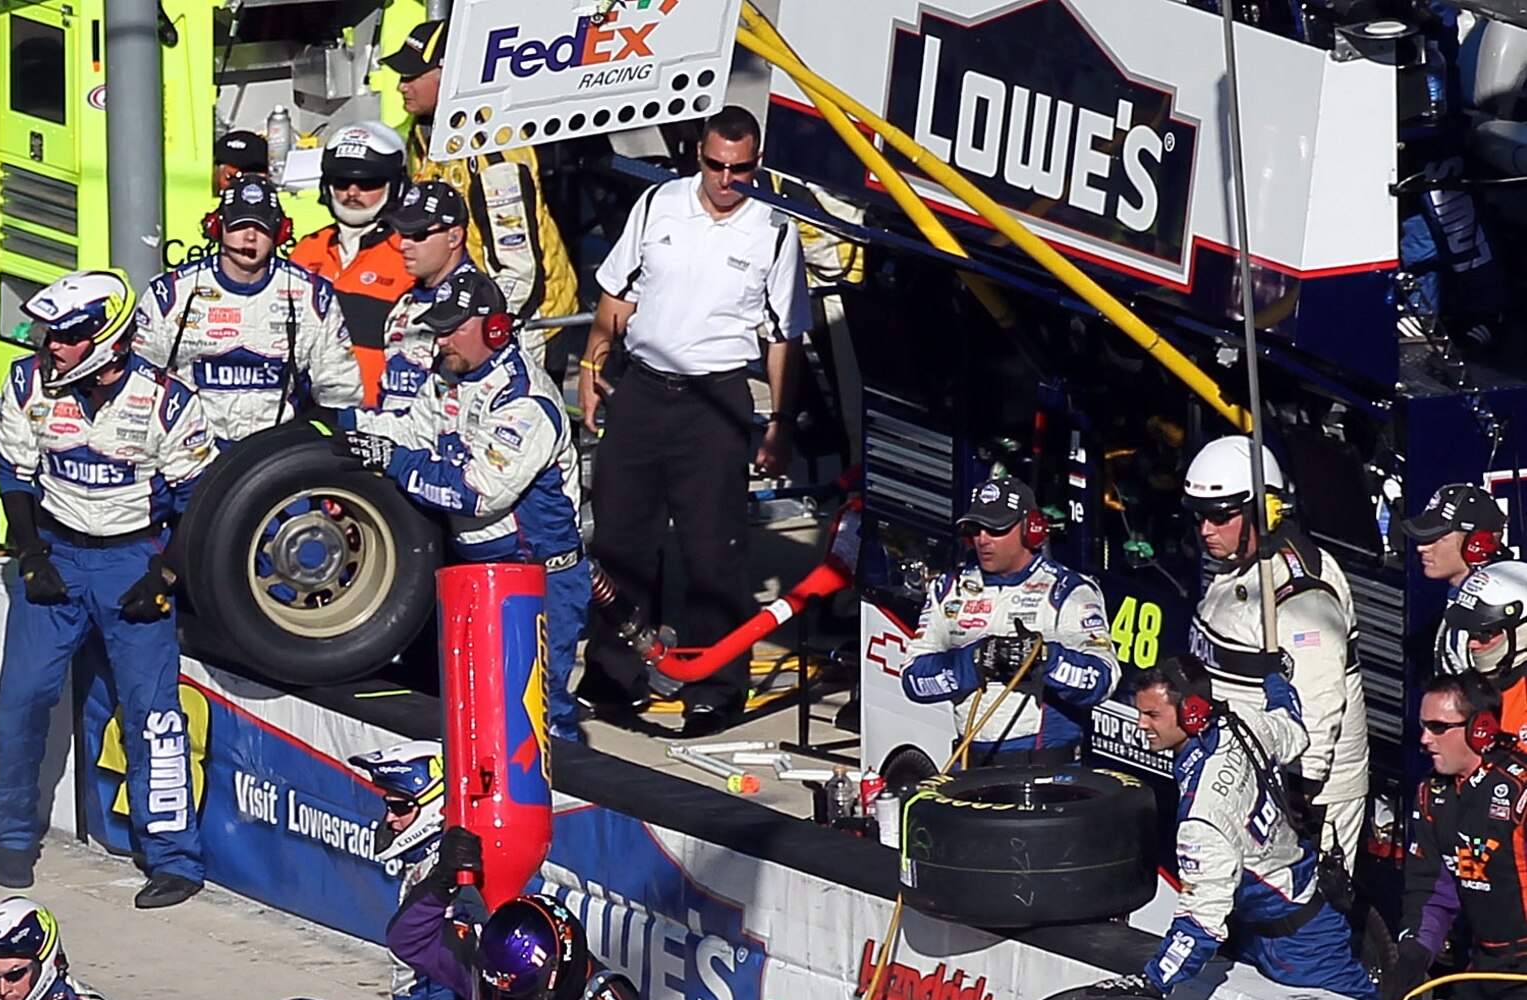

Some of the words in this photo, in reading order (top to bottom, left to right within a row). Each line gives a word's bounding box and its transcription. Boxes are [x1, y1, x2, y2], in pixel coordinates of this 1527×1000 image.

[481, 11, 660, 84] FedEx
[578, 64, 654, 90] RACING
[913, 34, 1165, 232] LOWE'S
[335, 145, 367, 158] TEXAS
[205, 360, 282, 385] LOWE'S
[55, 457, 125, 485] LOWE'S
[406, 468, 464, 511] LOWE'S
[1110, 595, 1163, 669] 48
[908, 670, 959, 698] LOWE'S
[1091, 711, 1120, 740] TOP
[146, 710, 189, 835] LOWE'S
[235, 770, 278, 825] Visit
[531, 945, 548, 968] 11
